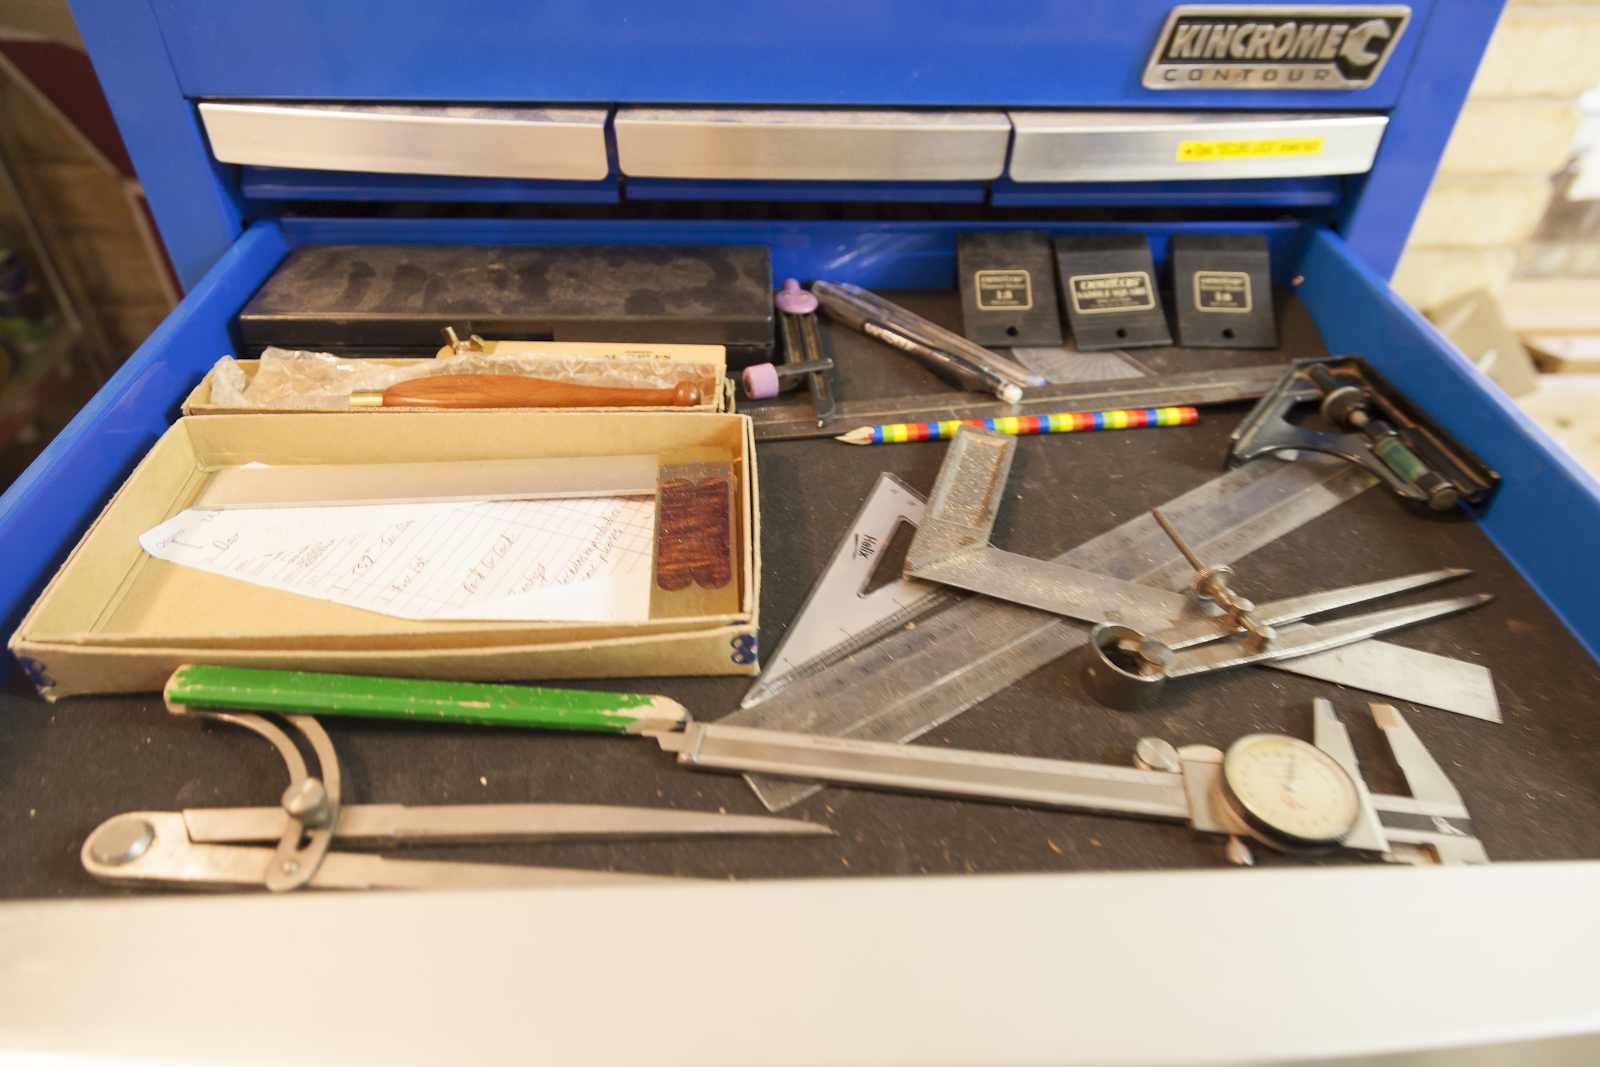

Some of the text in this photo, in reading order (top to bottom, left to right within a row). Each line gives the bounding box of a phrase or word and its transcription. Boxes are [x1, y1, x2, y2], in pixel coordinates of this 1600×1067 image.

[1167, 22, 1350, 59] KINCROME
[1163, 68, 1332, 83] CONTOUR
[858, 533, 878, 559] Helix
